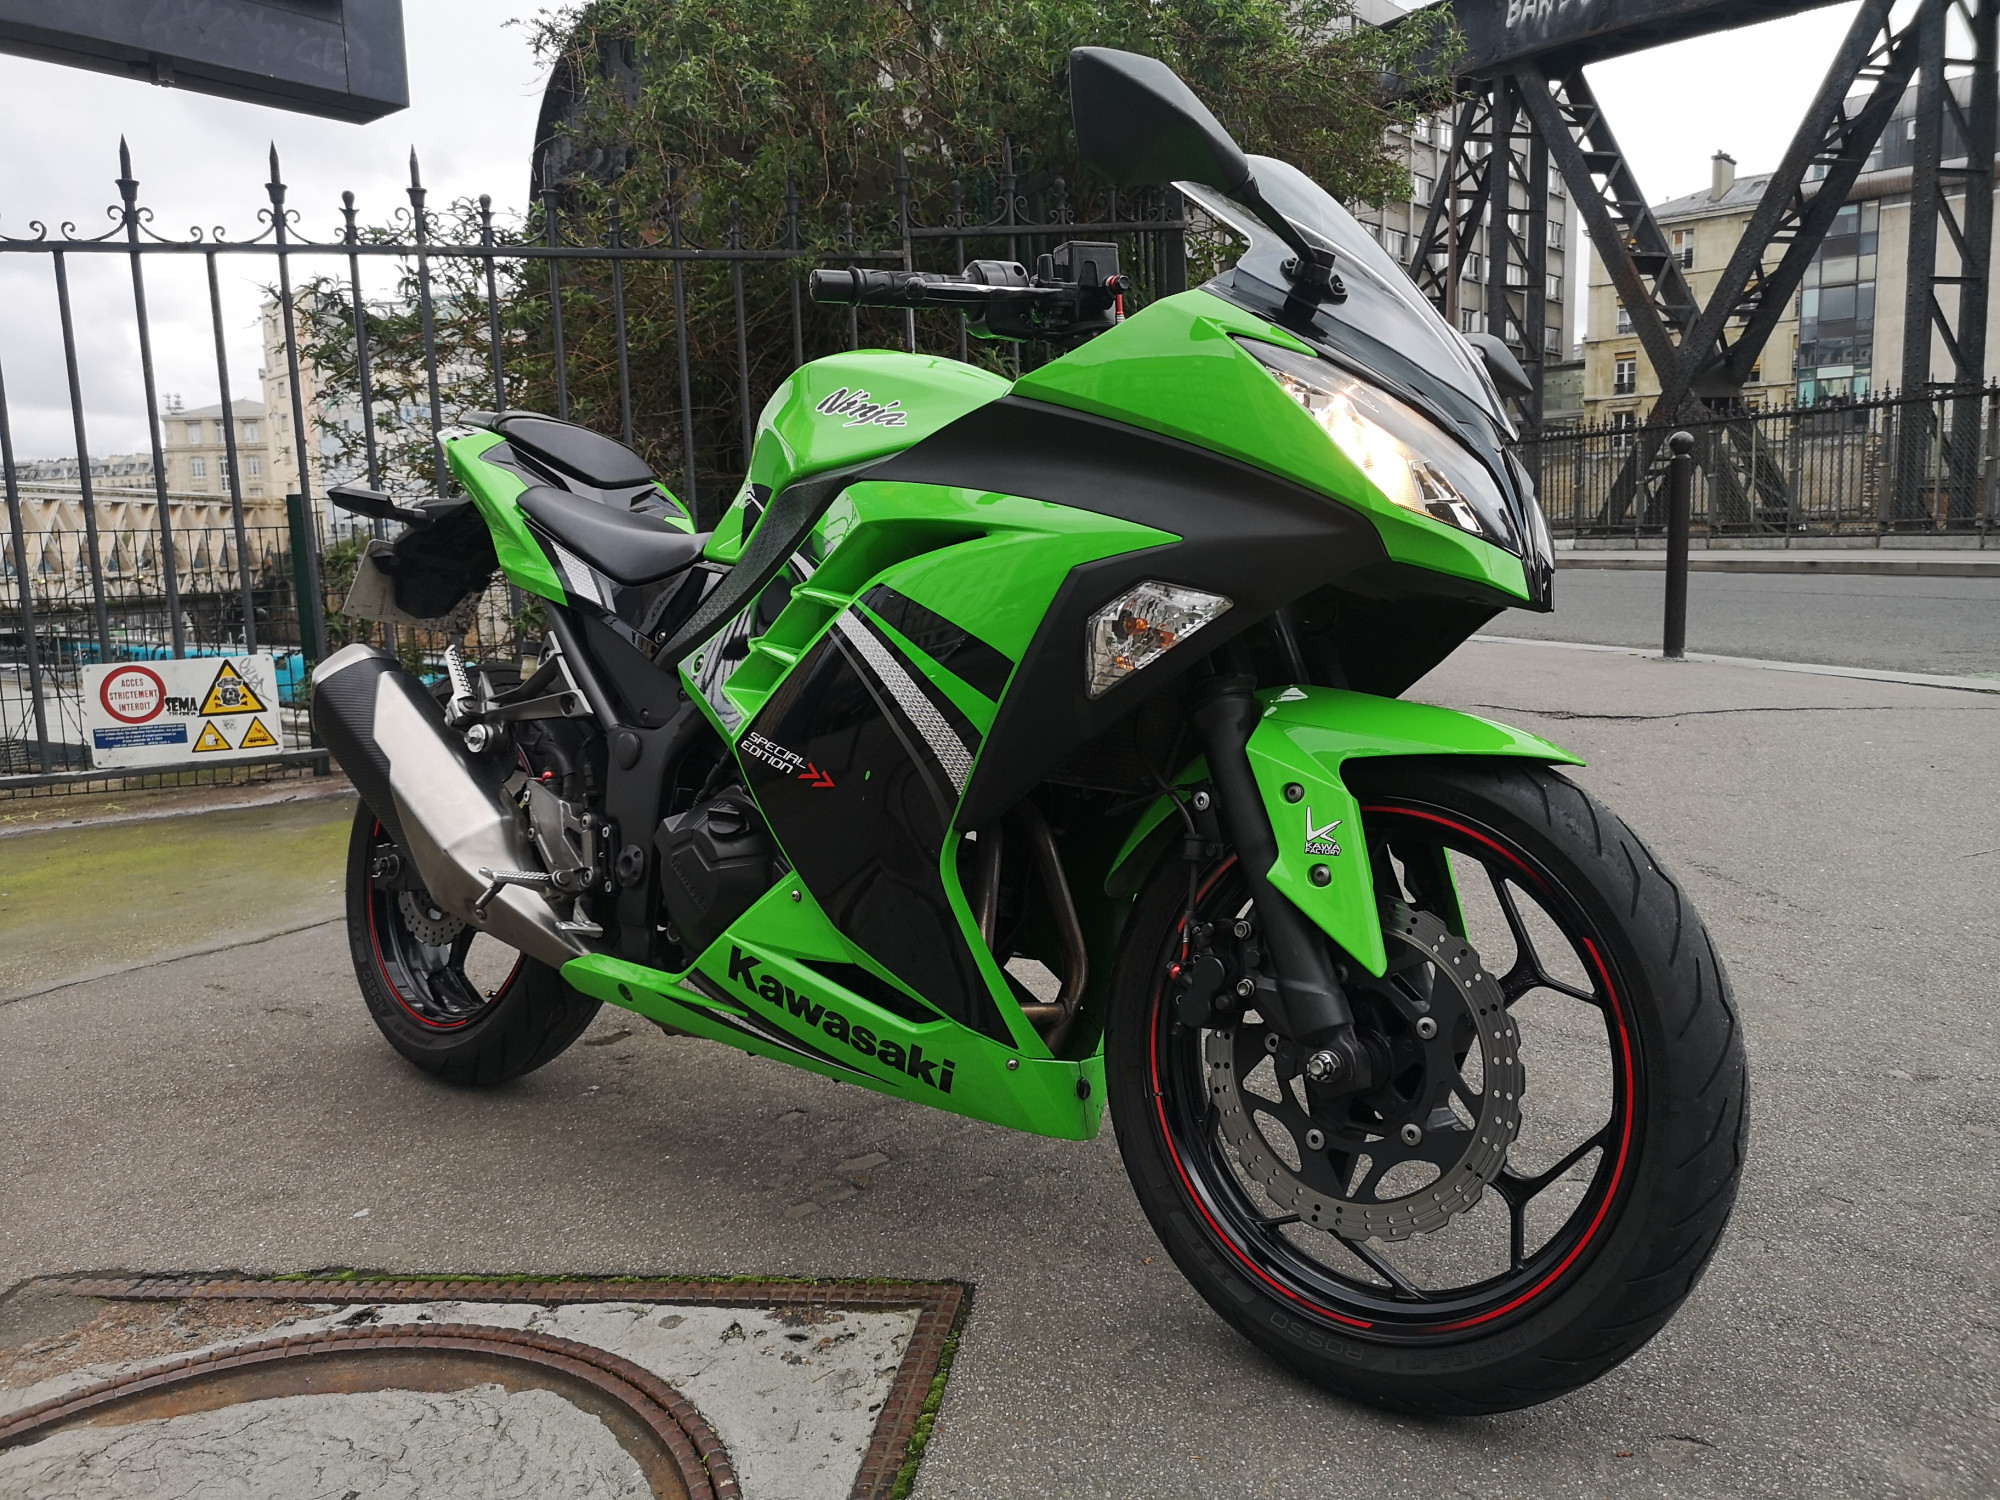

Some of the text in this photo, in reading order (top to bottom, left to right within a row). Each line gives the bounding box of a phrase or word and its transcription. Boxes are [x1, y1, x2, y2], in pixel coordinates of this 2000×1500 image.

[816, 387, 907, 427] Ninja
[121, 678, 144, 687] ACCES
[109, 689, 158, 700] STRICTEMENT
[119, 701, 151, 711] INTERDIT
[165, 697, 198, 711] SEMA
[740, 740, 794, 774] EDITION
[748, 731, 806, 769] SPECIAL
[1304, 848, 1342, 856] FACTORY
[1305, 842, 1341, 850] KAWA
[728, 944, 956, 1095] Kawasaki
[1269, 1309, 1365, 1361] ROSSO
